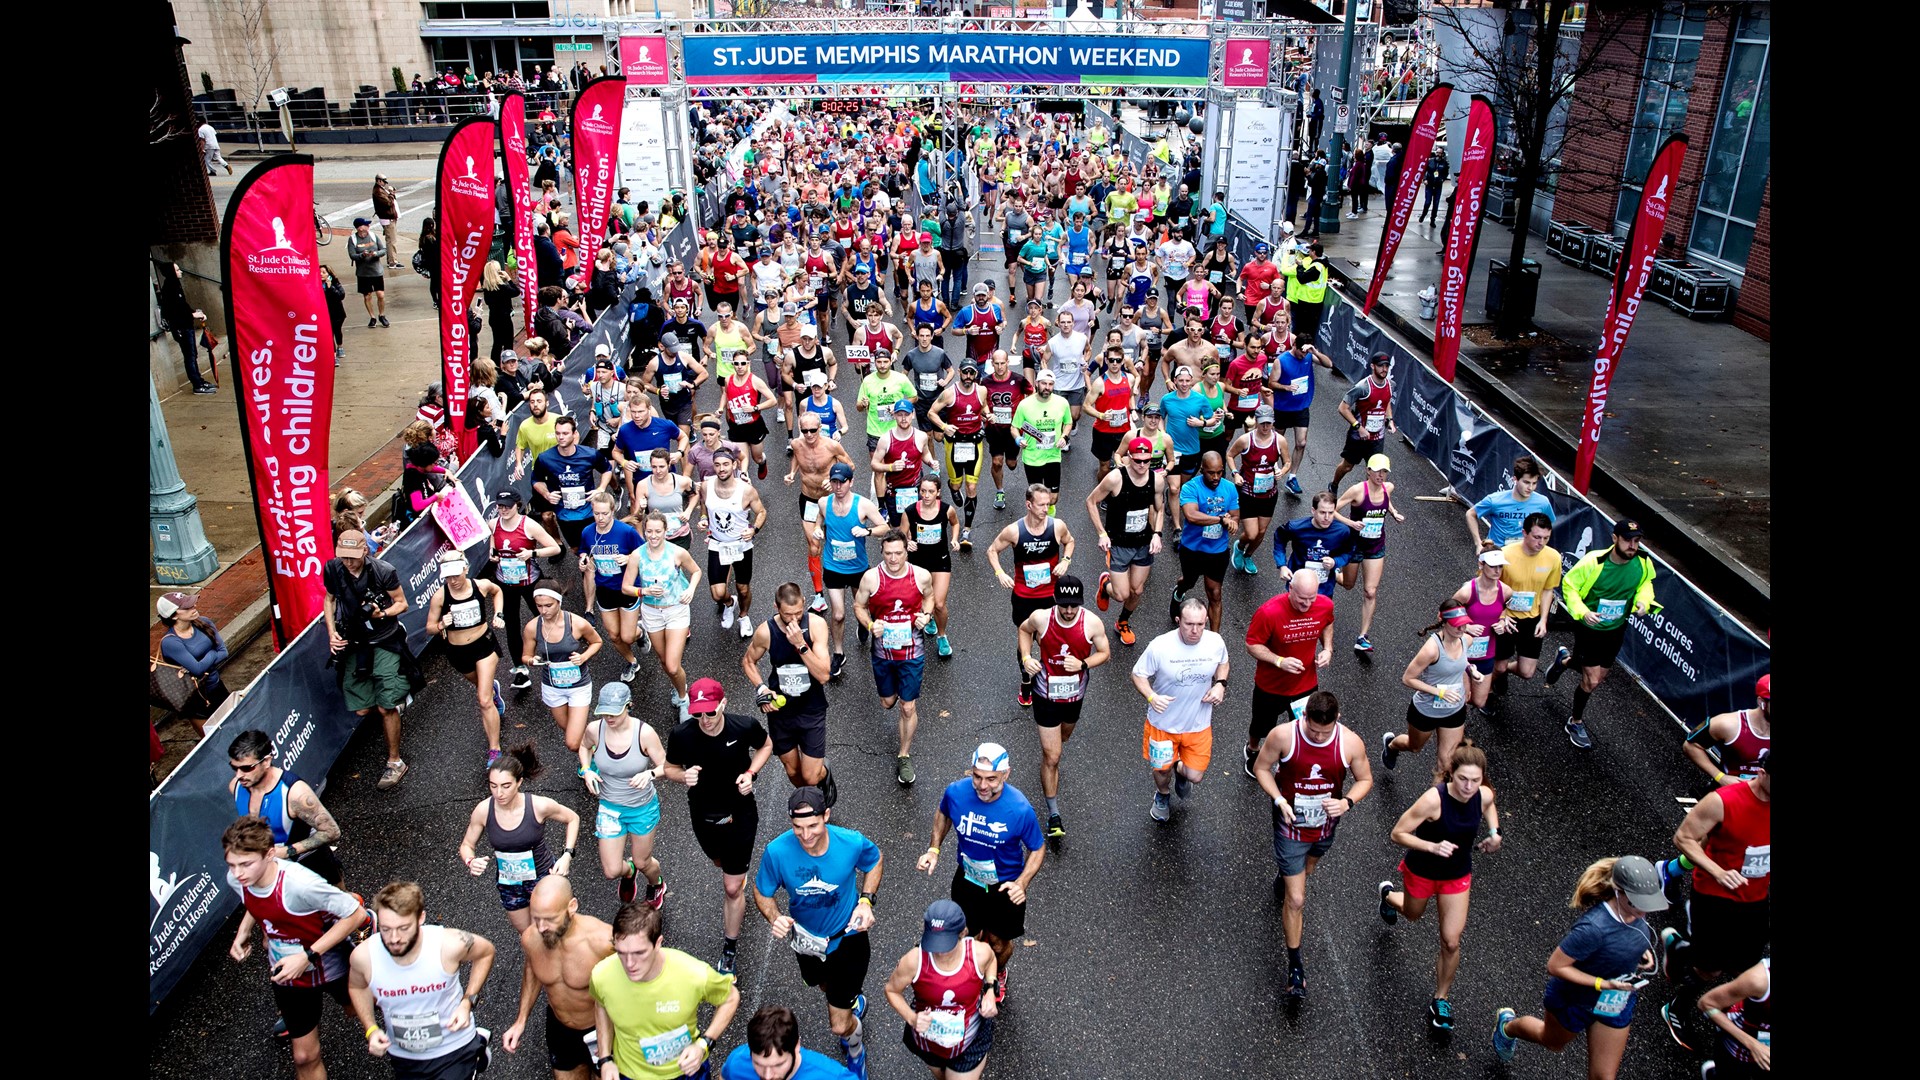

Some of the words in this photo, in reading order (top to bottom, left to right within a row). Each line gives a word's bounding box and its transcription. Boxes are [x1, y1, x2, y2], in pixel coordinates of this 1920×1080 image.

[816, 45, 920, 65] MEMPHIS
[1070, 48, 1181, 68] WEEKEND
[589, 152, 610, 230] children.
[248, 254, 260, 263] St.
[260, 255, 281, 265] Jude
[248, 264, 289, 275] Research
[848, 349, 869, 357] 3:20
[447, 323, 466, 417] Finding
[281, 313, 318, 456] children.
[288, 464, 322, 579] Saving
[1500, 511, 1527, 519] GRIZZL
[409, 559, 438, 592] Finding
[415, 584, 440, 610] Saving
[453, 608, 480, 621] 30613
[1665, 620, 1695, 654] cures.
[1625, 613, 1655, 645] aving
[1654, 635, 1697, 683] children.
[551, 668, 580, 679] 14509
[784, 675, 802, 686] 392
[1053, 684, 1075, 693] 1981
[276, 708, 301, 745] cures.
[283, 720, 316, 771] children.
[973, 813, 987, 823] LIFE
[972, 826, 999, 839] Runners
[501, 860, 529, 872] 5053
[154, 919, 176, 952] Jude
[172, 871, 212, 923] Children's
[149, 925, 190, 977] Research
[184, 881, 221, 930] Hospital
[376, 987, 408, 998] Team
[411, 981, 447, 994] Porter
[656, 1005, 680, 1013] HERO
[403, 1027, 430, 1040] 445
